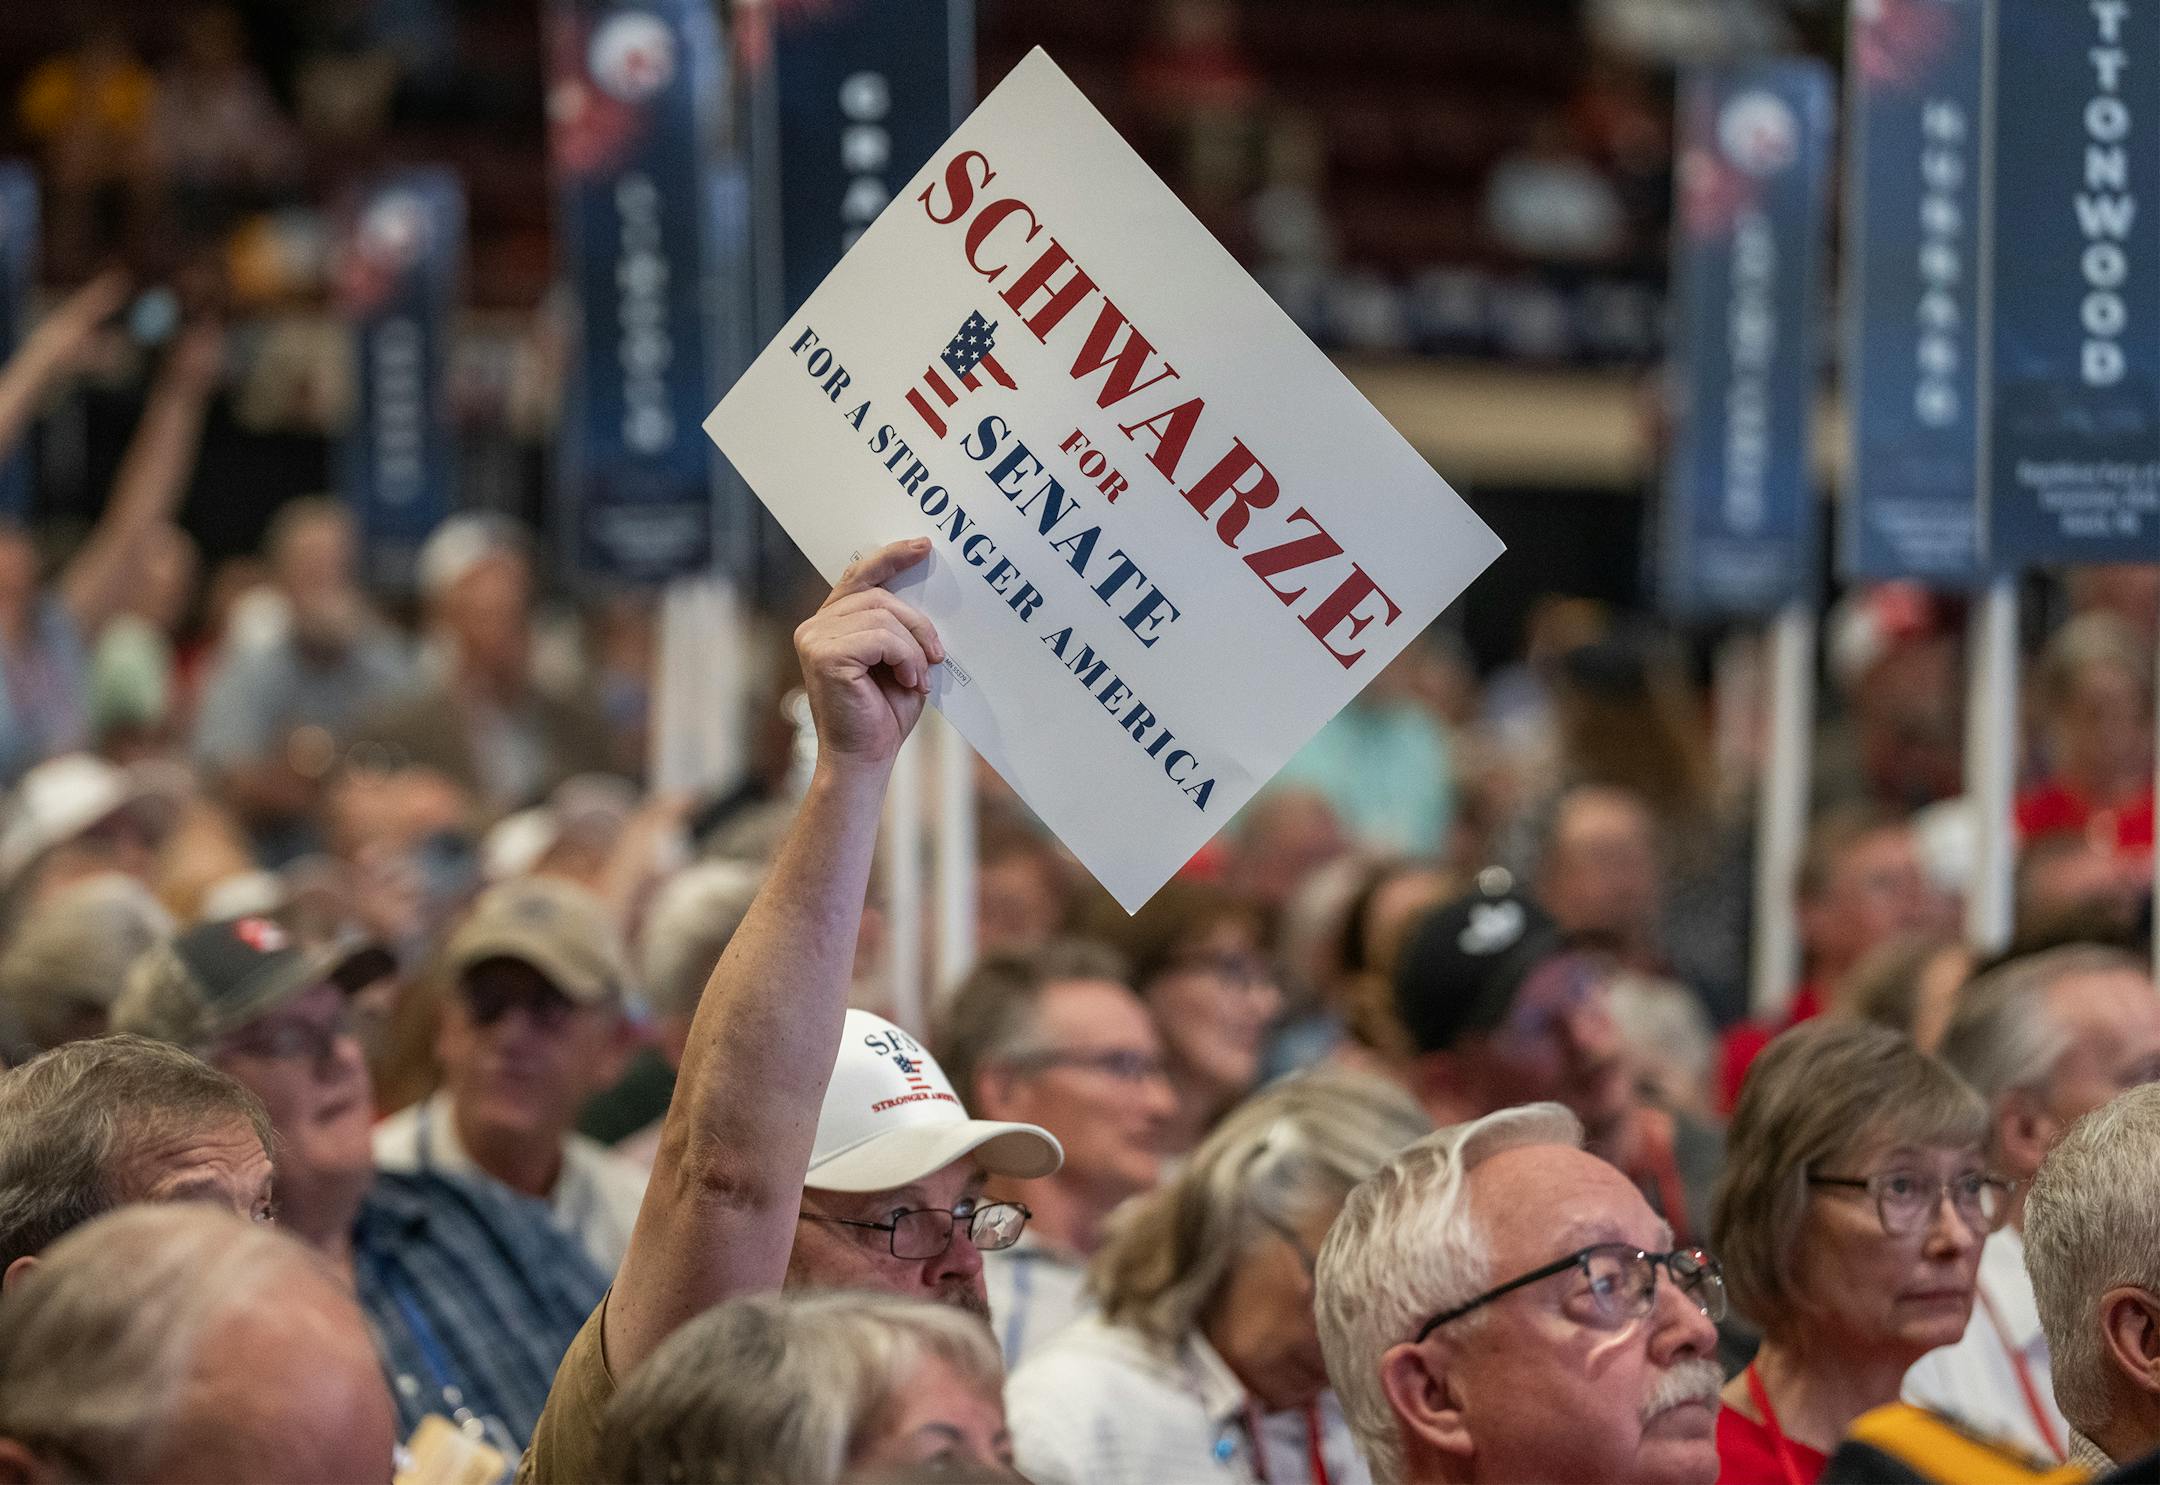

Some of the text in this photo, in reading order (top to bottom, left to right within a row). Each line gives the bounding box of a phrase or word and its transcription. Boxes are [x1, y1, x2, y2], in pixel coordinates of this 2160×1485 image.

[917, 149, 1404, 671] SCHWARZE
[1058, 429, 1129, 504] FOR
[788, 326, 1217, 814] FOR A STRONGER AMERICA
[960, 414, 1183, 650] SENATE
[944, 657, 954, 669] MN
[871, 1092, 929, 1113] STRONGER
